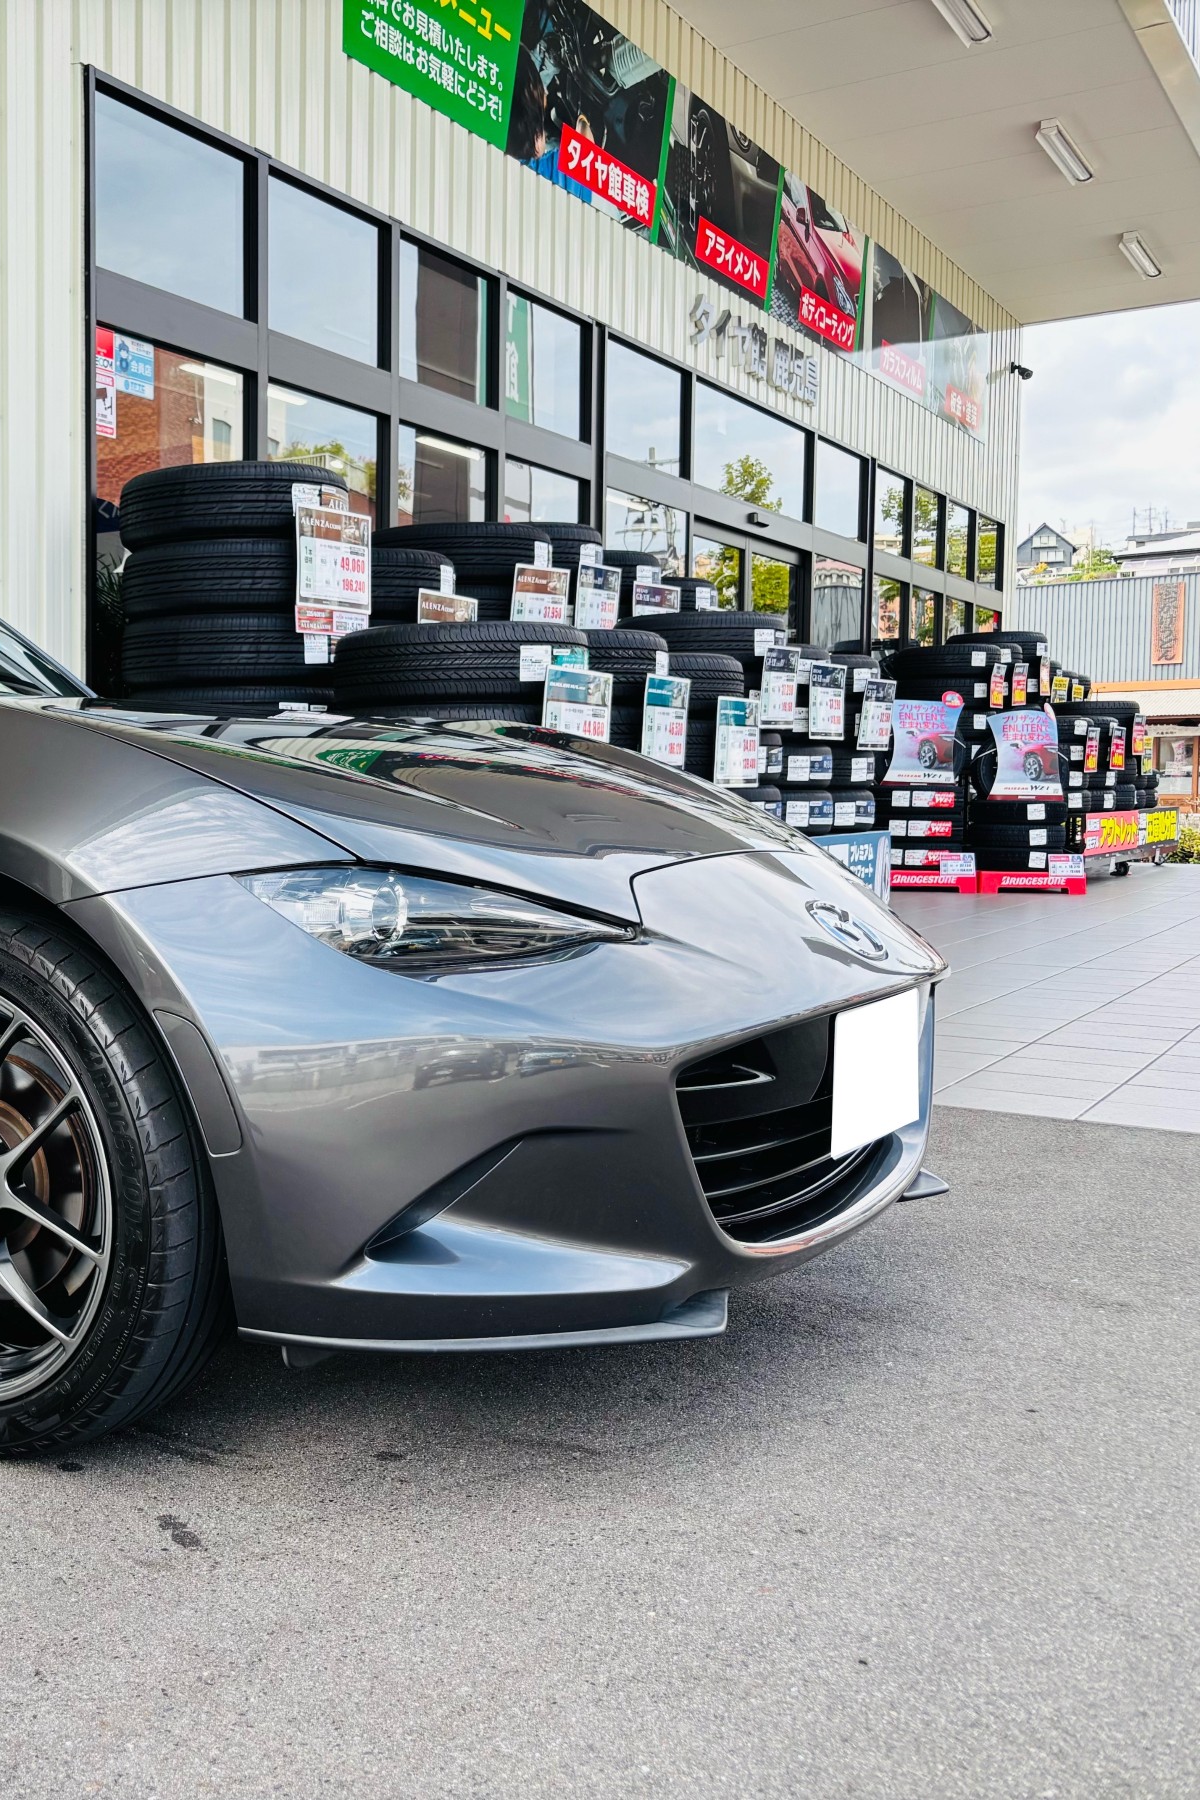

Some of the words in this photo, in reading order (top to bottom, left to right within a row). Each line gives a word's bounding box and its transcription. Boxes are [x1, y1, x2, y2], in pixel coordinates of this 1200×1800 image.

[566, 138, 650, 221] タイヤ館車検
[704, 228, 761, 289] アライメント
[883, 346, 923, 392] ガラスフィルム
[300, 516, 330, 529] ALENZA
[341, 556, 365, 574] 49,060
[517, 575, 539, 584] ALENZA
[421, 602, 445, 611] ALENZA
[898, 712, 947, 721] ENLITENで
[1002, 723, 1049, 733] ENLITENで
[1100, 815, 1138, 849] アウトレット
[892, 874, 957, 884] BRIDGESTONE
[1001, 876, 1066, 885] BRIDGESTONE
